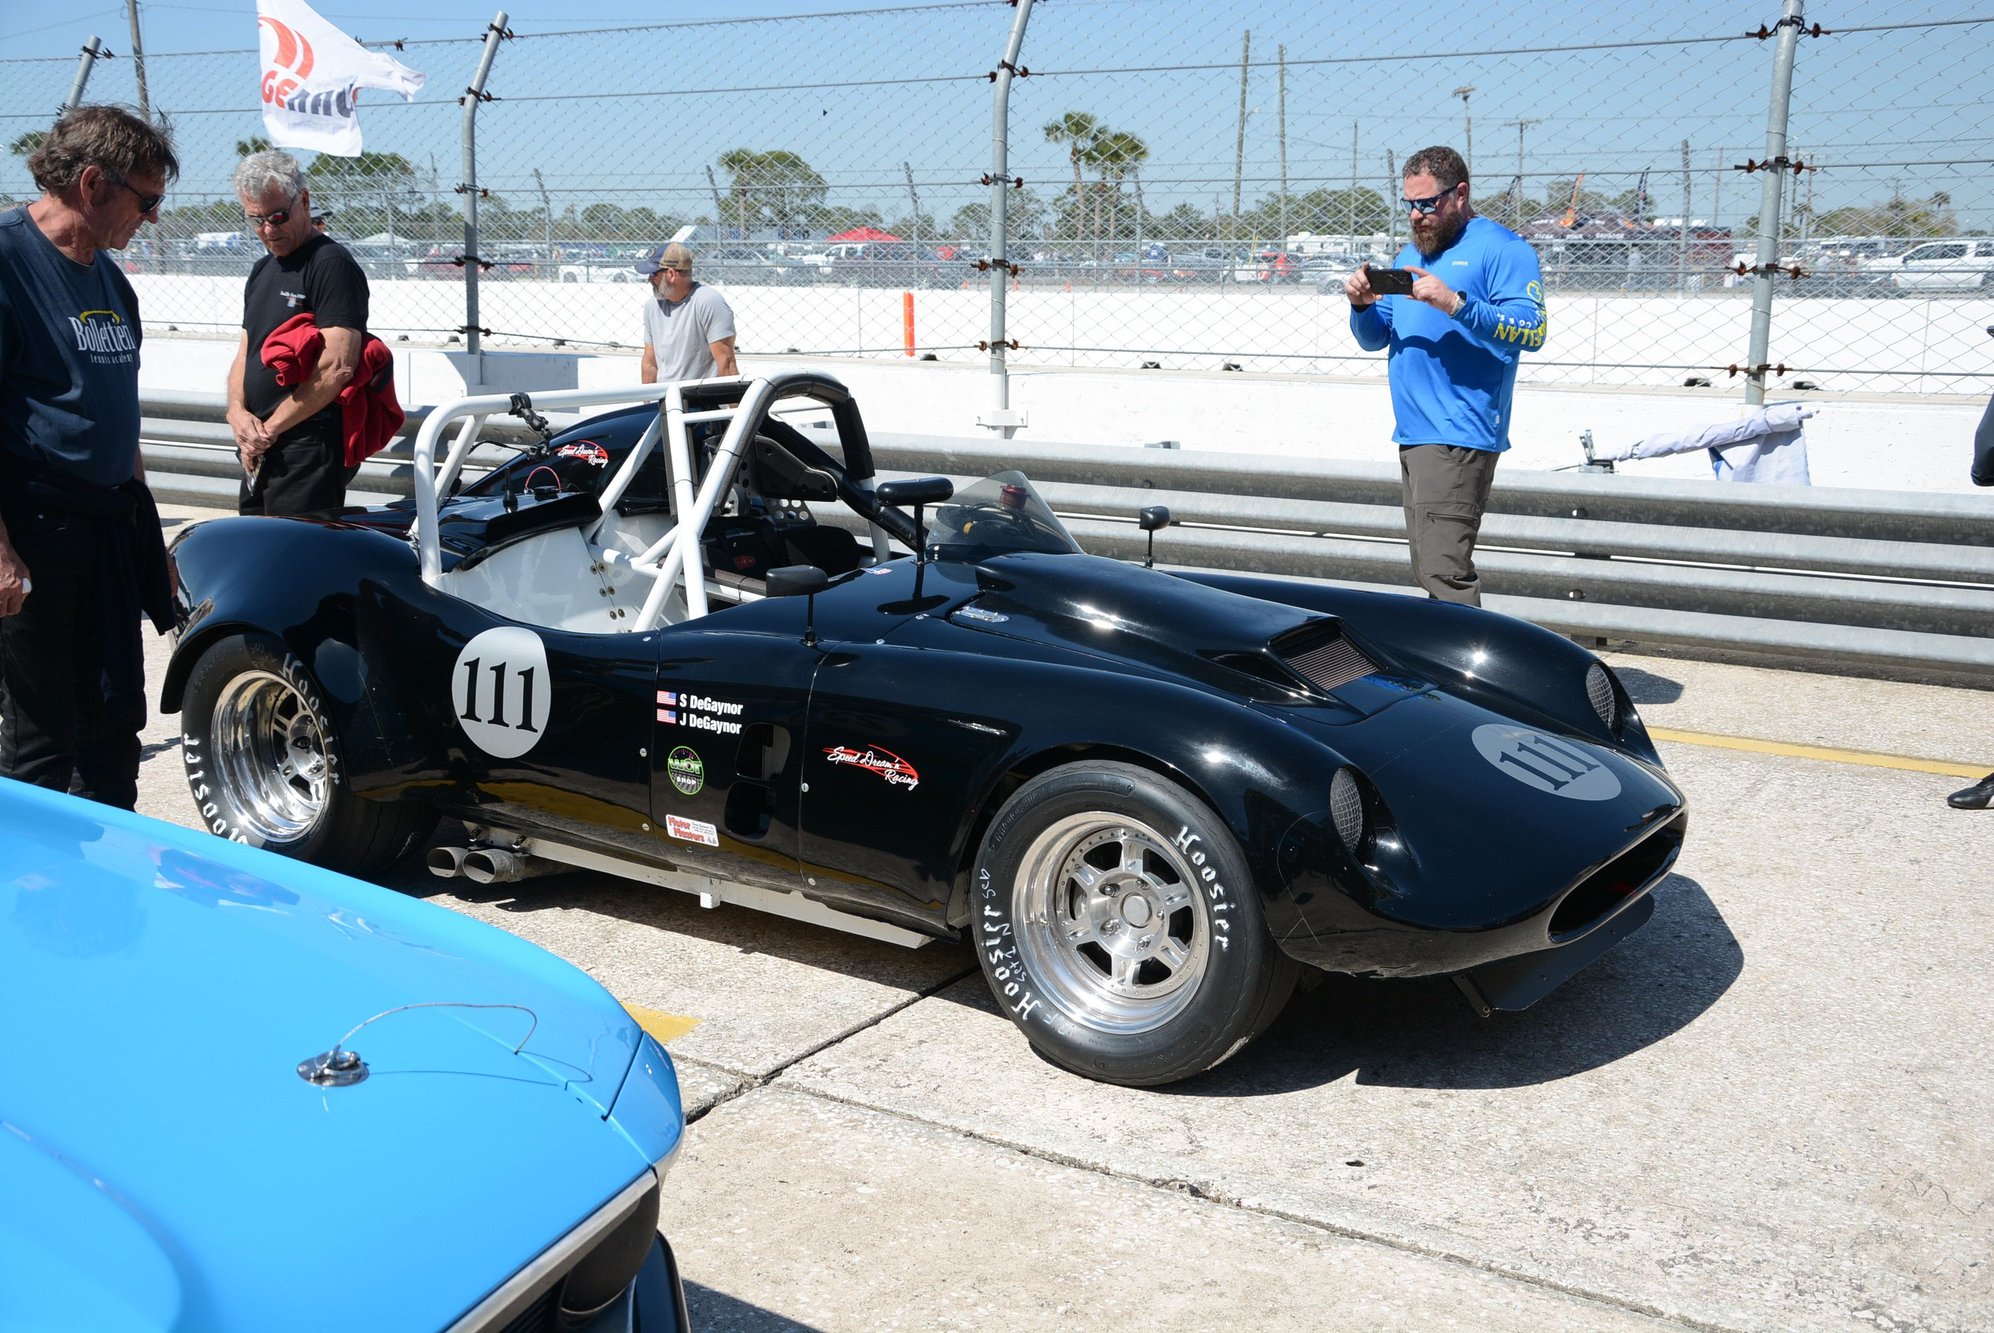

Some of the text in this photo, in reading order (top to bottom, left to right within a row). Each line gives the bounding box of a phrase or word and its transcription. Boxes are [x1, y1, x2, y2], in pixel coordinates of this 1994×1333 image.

[460, 657, 538, 733] 111
[679, 693, 743, 715] S DeGaynor
[679, 713, 742, 734] J DeGaynor
[827, 746, 861, 765] Speed
[1499, 736, 1600, 791] 111
[884, 768, 919, 791] Racing
[1170, 825, 1236, 952] Hoosier
[981, 904, 1043, 1022] Hoosier
